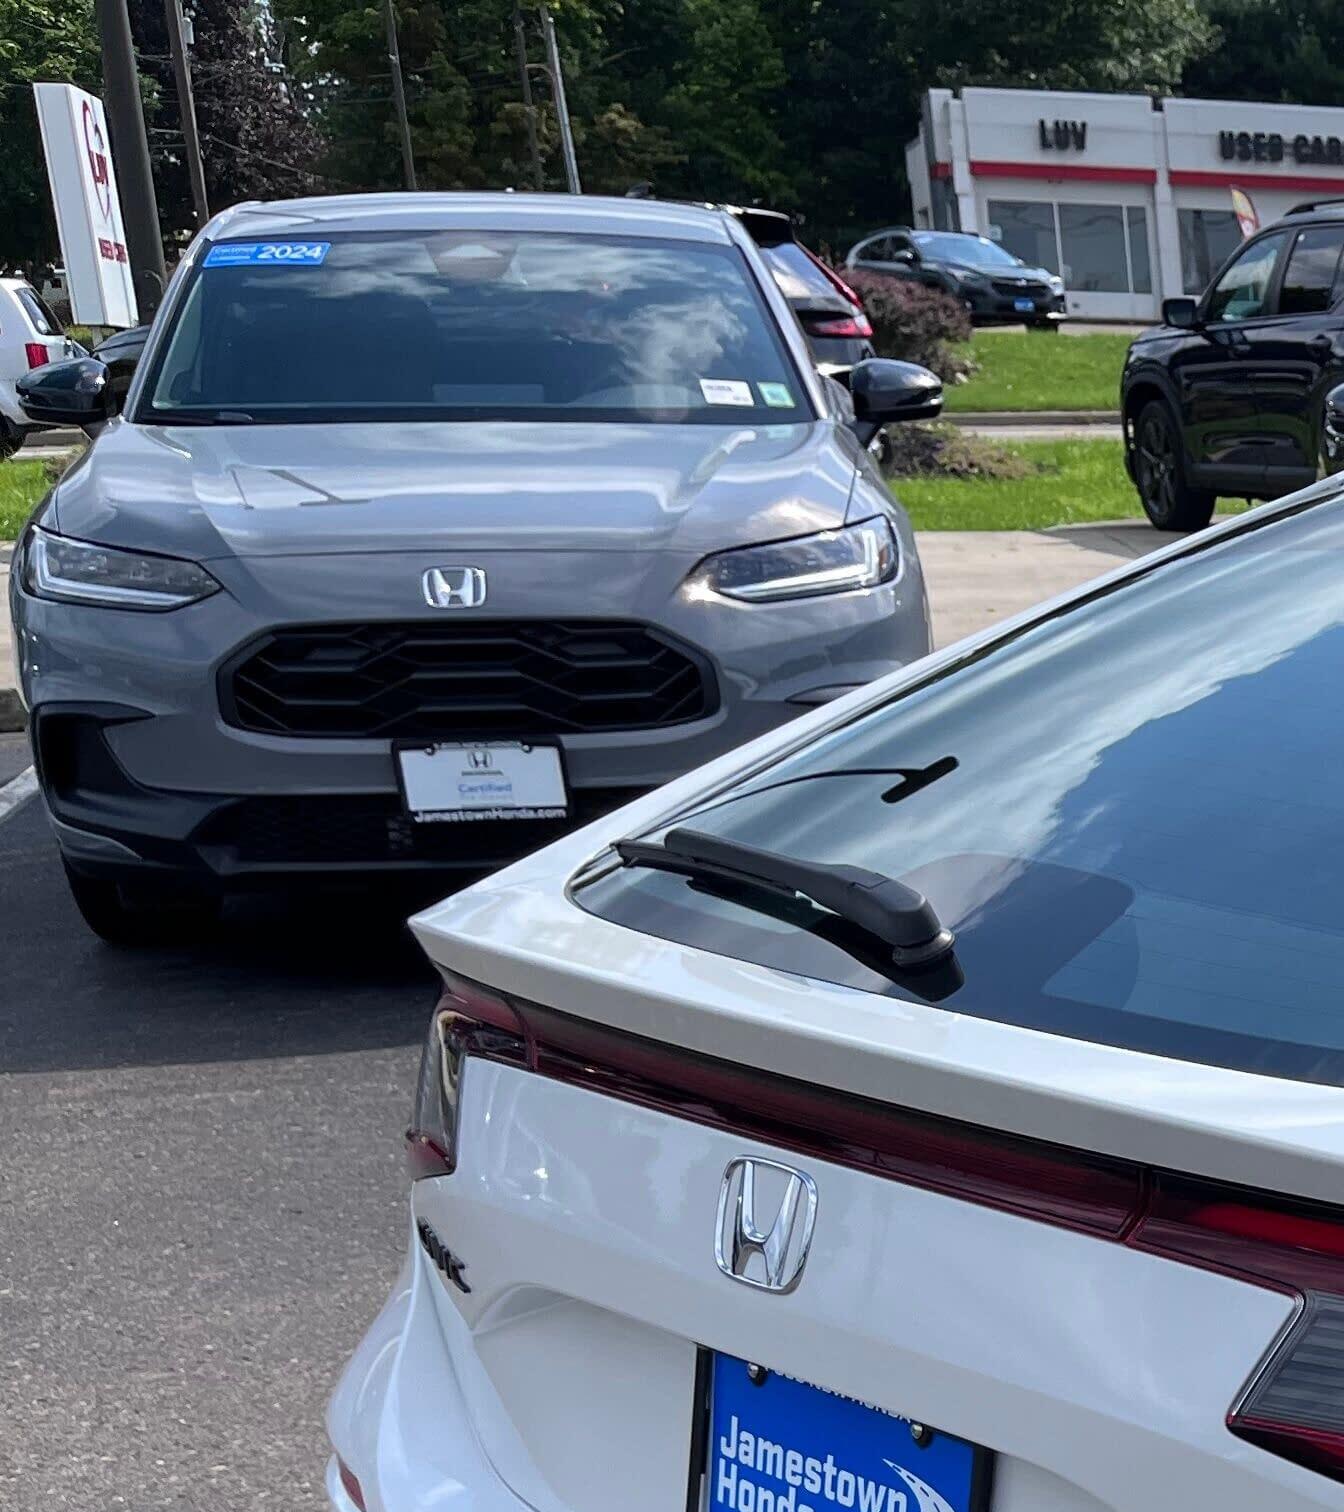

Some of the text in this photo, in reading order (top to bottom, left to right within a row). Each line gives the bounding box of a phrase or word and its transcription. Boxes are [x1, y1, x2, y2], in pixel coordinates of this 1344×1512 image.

[1039, 119, 1087, 151] LUV
[1219, 130, 1284, 161] USED
[257, 245, 322, 259] 2024
